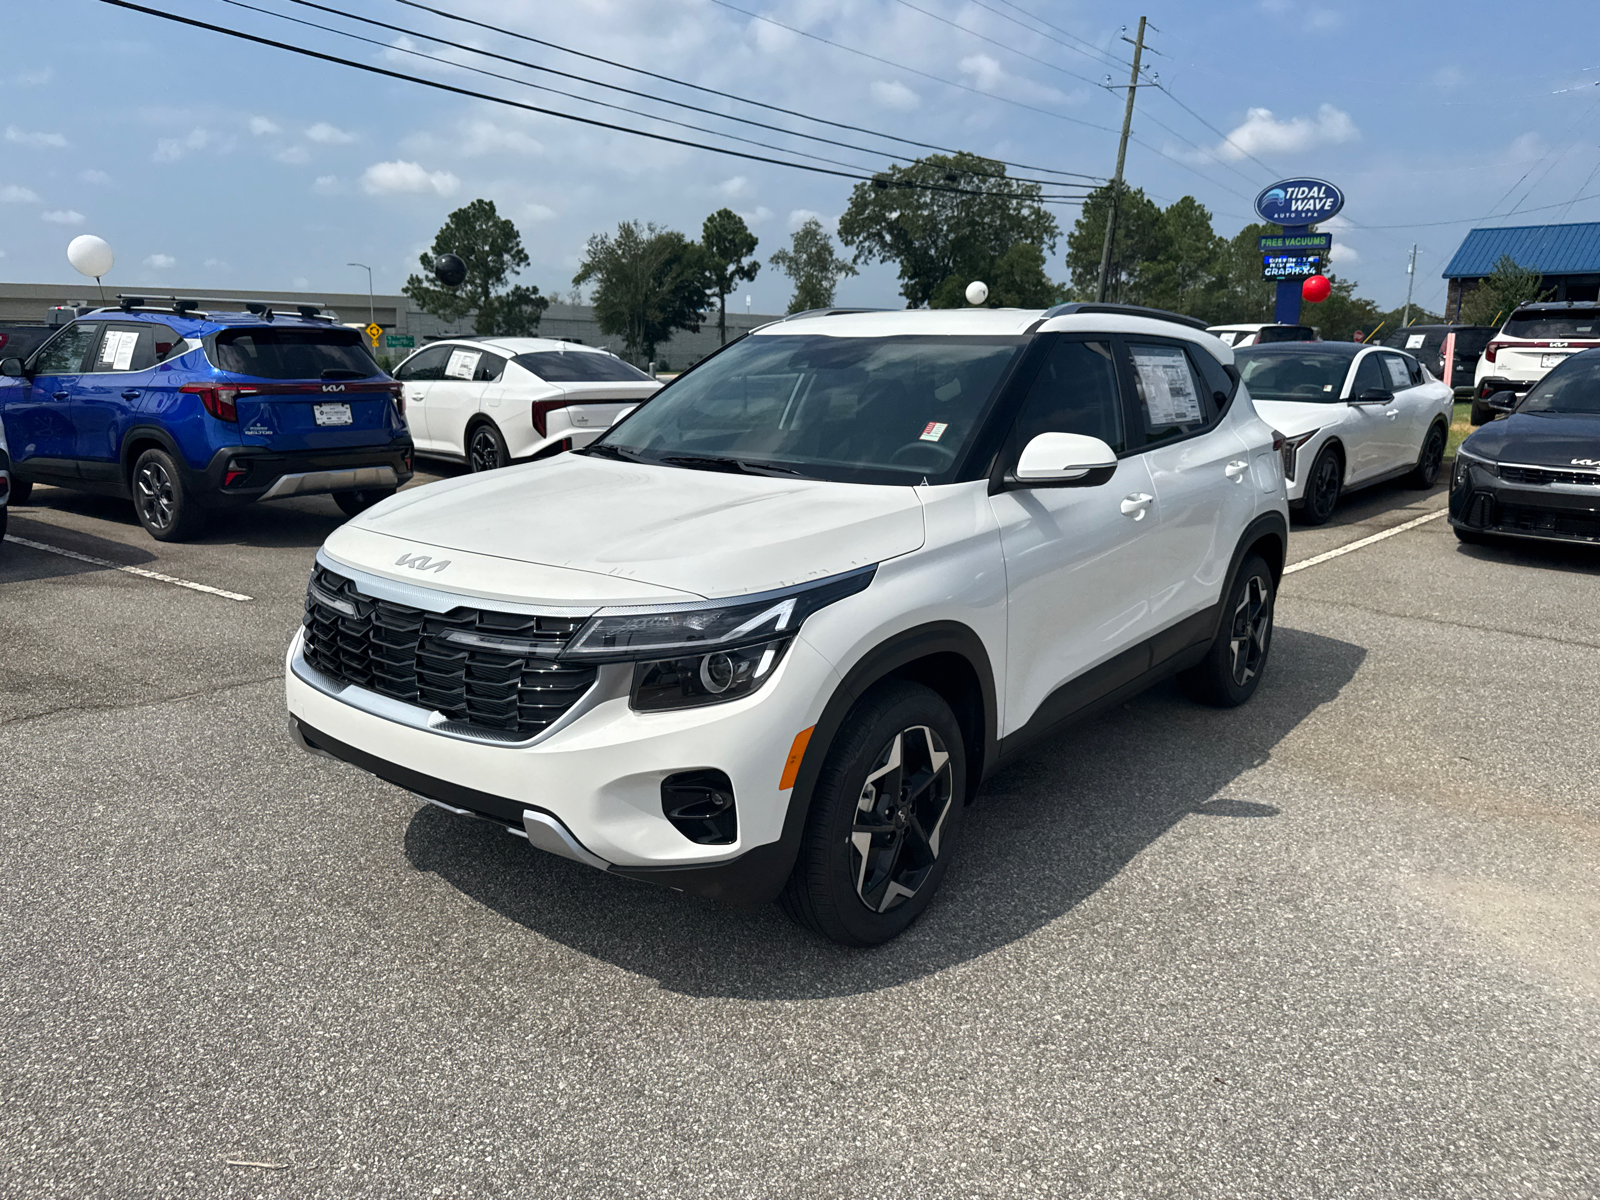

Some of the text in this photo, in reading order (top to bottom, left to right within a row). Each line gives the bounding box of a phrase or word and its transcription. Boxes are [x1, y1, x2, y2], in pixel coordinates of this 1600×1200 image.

[1286, 186, 1326, 199] TIDAL
[1291, 198, 1334, 211] WAVE
[1261, 236, 1326, 247] FREE VACUUMS
[322, 384, 346, 392] KIA
[395, 552, 452, 574] KIA
